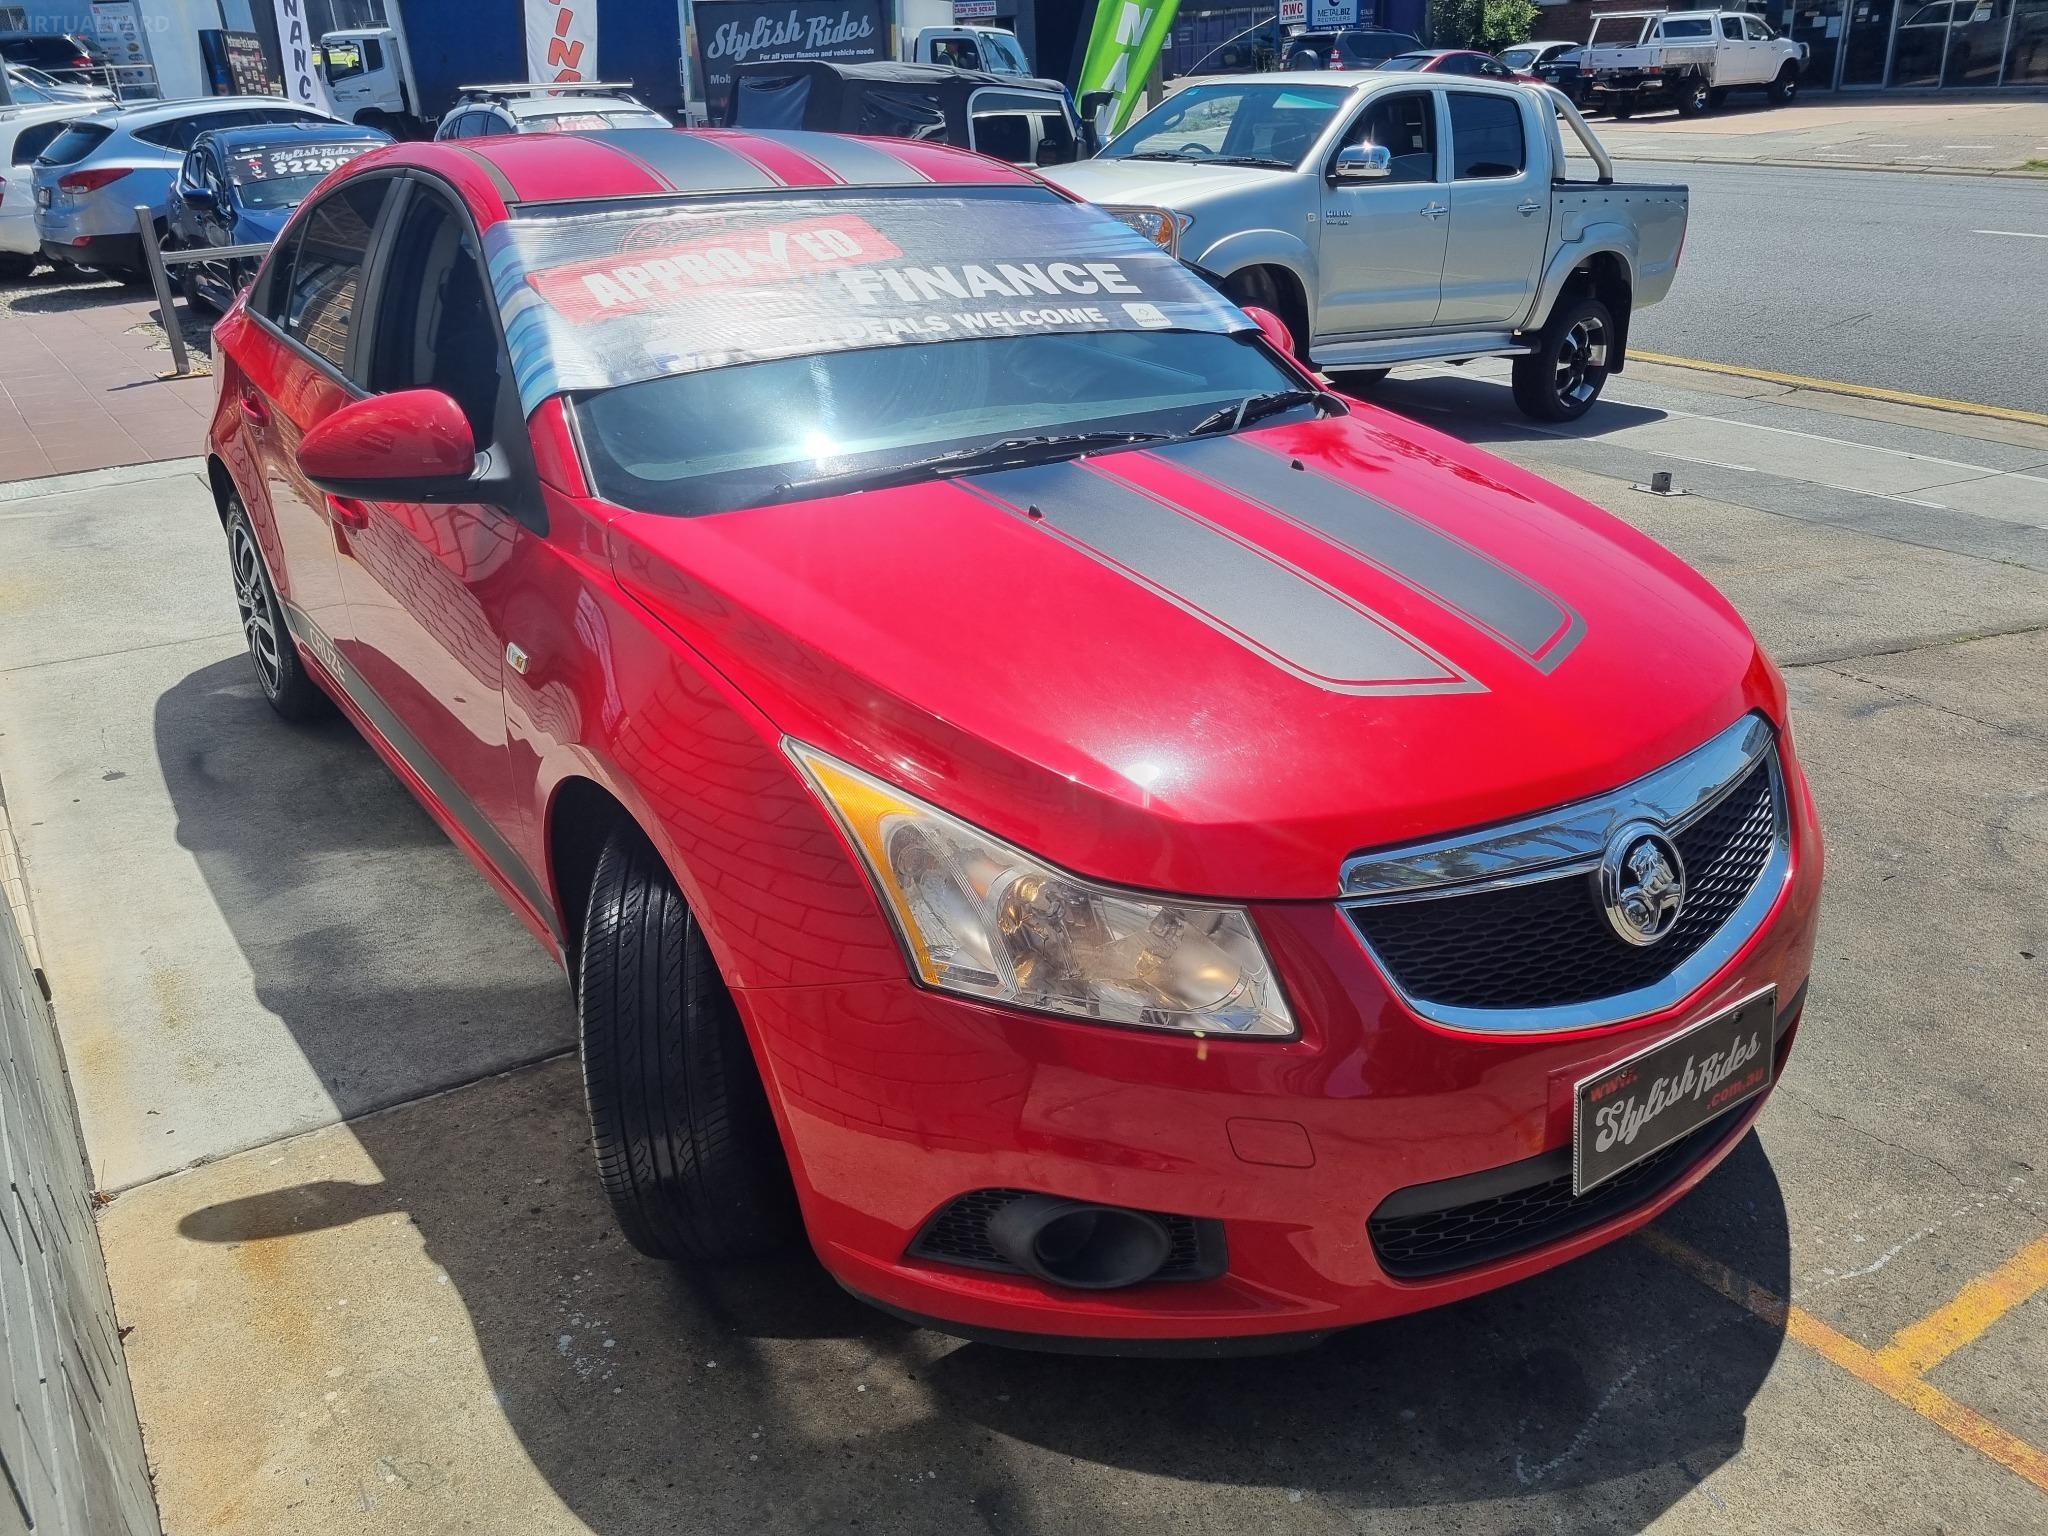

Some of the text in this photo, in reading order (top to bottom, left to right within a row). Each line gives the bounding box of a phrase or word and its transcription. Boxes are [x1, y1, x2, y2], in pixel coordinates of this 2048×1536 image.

[1283, 3, 1303, 16] RWC
[707, 10, 874, 61] Stylish Rides
[771, 52, 780, 60] all
[781, 53, 795, 62] your
[796, 50, 819, 59] finance
[834, 48, 855, 56] vehicle
[856, 47, 875, 55] needs
[270, 147, 359, 162] Stylish Rides
[836, 262, 1143, 306] FINANCE
[951, 307, 1110, 329] WELCOME
[309, 627, 346, 683] CRUZE
[1595, 1031, 1761, 1153] Stylish Rides
[1707, 1067, 1766, 1110] .com.au
